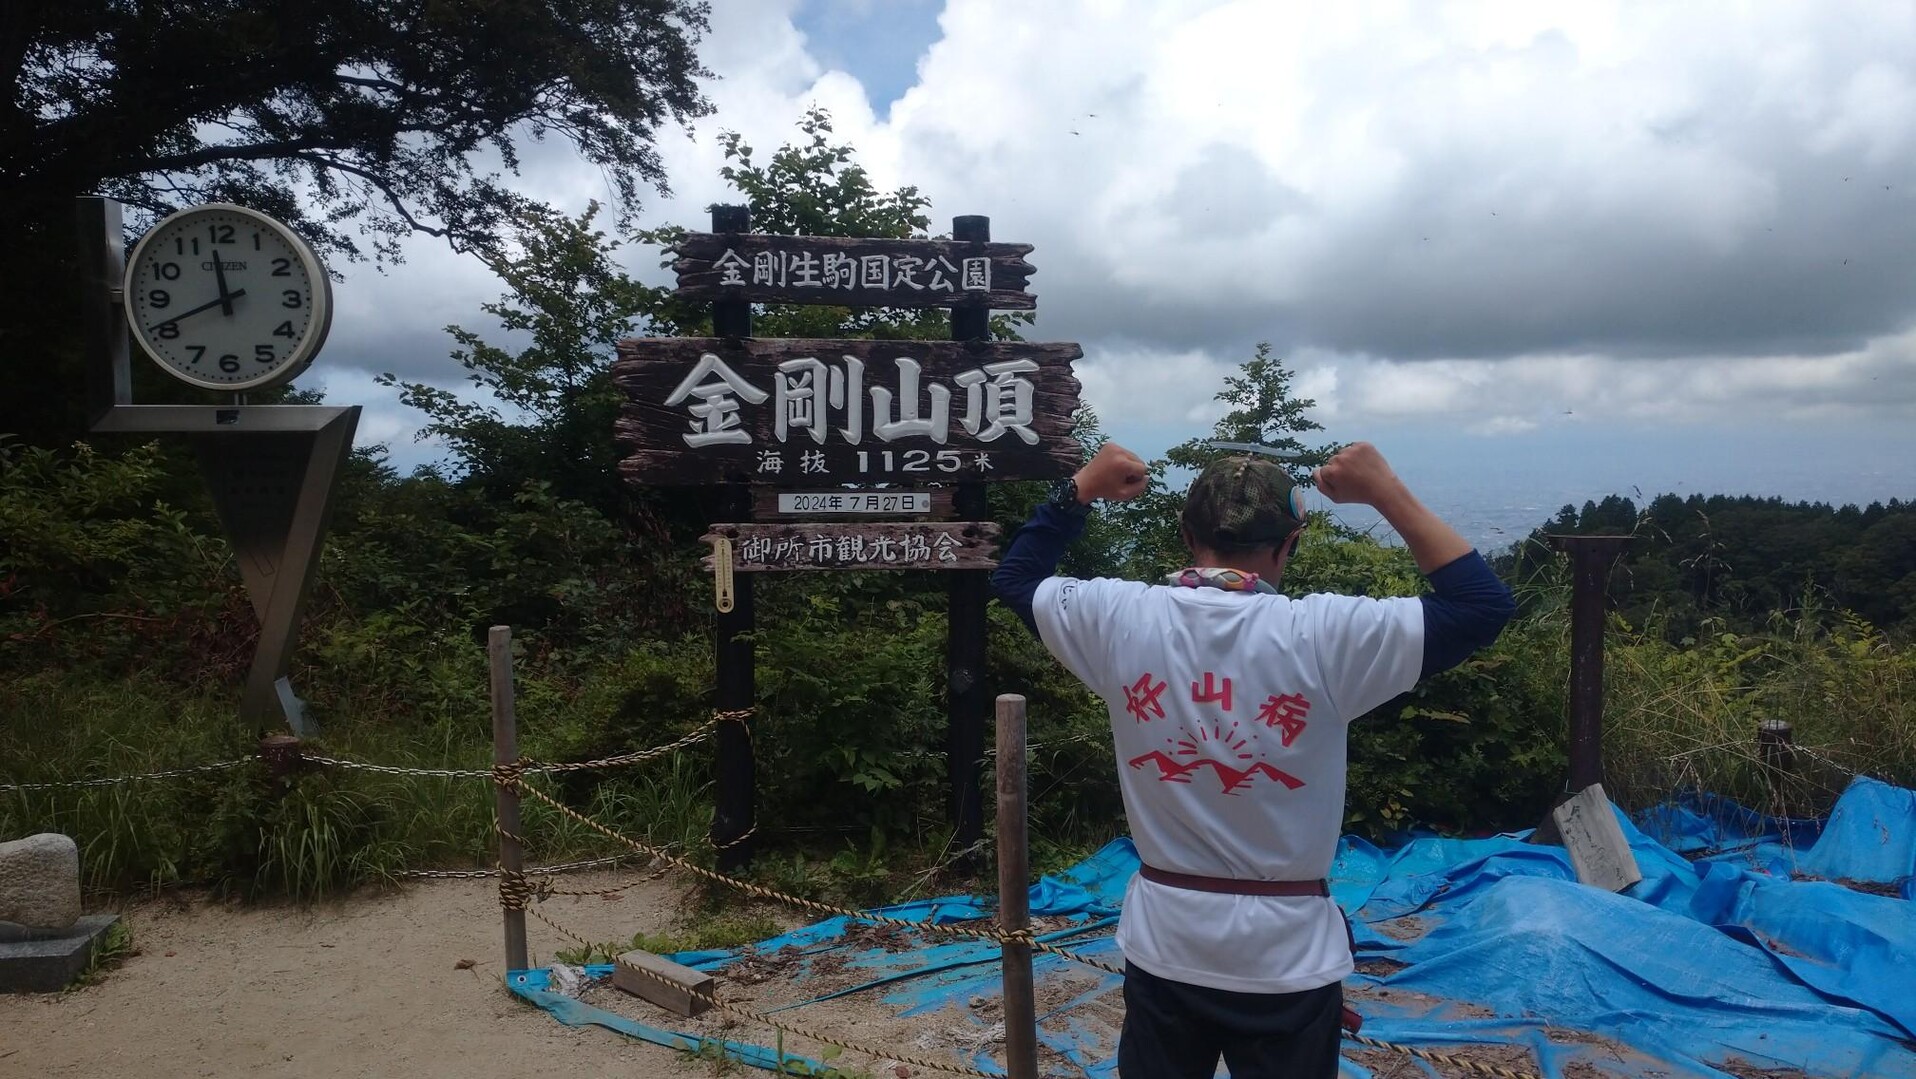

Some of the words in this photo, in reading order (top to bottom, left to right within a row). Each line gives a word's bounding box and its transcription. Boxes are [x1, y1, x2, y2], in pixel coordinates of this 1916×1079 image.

[208, 224, 236, 244] 12
[252, 233, 261, 251] 1
[175, 236, 200, 256] 11
[151, 261, 181, 281] 10
[271, 257, 291, 277] 2
[712, 248, 992, 294] 金剛生駒国定公園
[149, 289, 171, 309] 9
[281, 289, 302, 309] 3
[158, 321, 180, 340] 8
[272, 320, 295, 339] 4
[185, 345, 206, 364] 7
[218, 354, 241, 373] 6
[255, 344, 276, 363] 5
[663, 352, 1041, 449] 金剛山頂
[742, 532, 964, 563] 御所市観光協会
